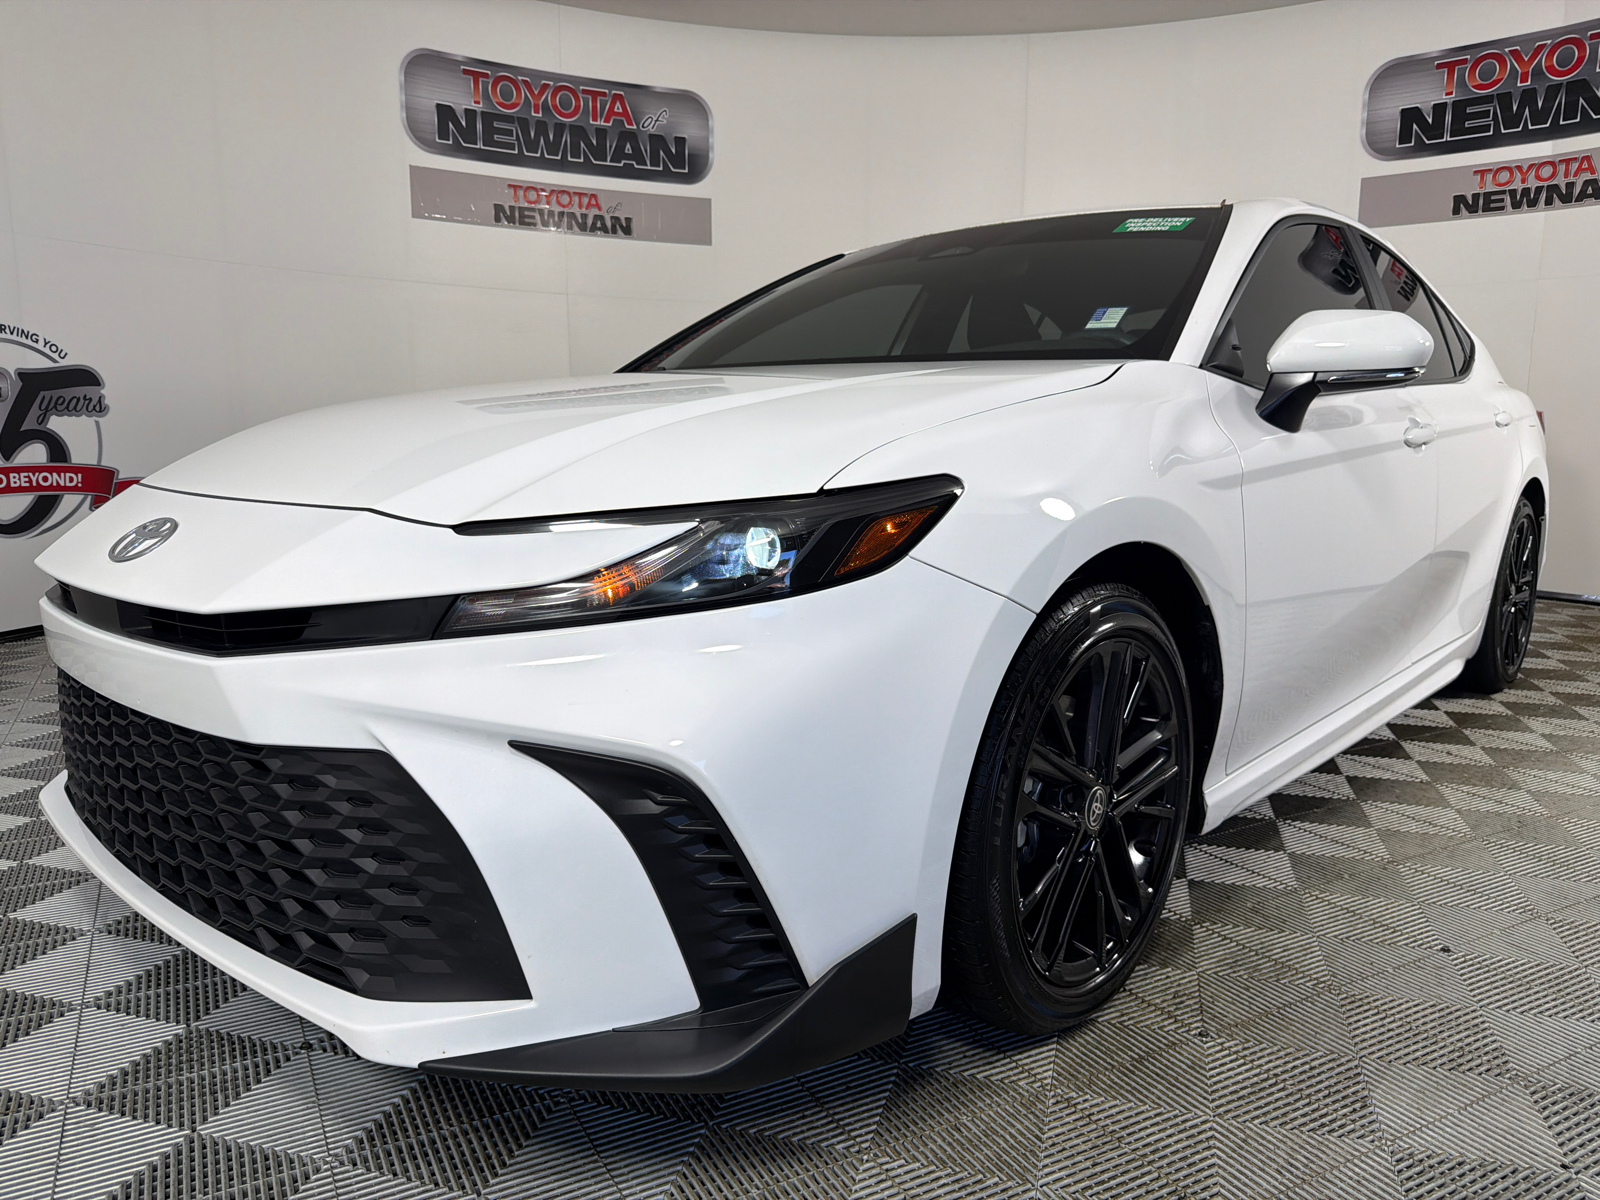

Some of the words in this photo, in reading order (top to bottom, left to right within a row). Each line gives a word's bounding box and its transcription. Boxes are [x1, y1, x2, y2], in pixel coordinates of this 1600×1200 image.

[461, 66, 635, 128] TOYOTA
[640, 108, 668, 131] of
[435, 102, 689, 173] NEWNAN
[1473, 153, 1597, 191] TOYOTA
[508, 183, 602, 211] TOYOTA
[493, 203, 633, 237] NEWNAN
[43, 337, 68, 360] YOU
[36, 393, 107, 426] years
[9, 472, 82, 488] BEYOND!
